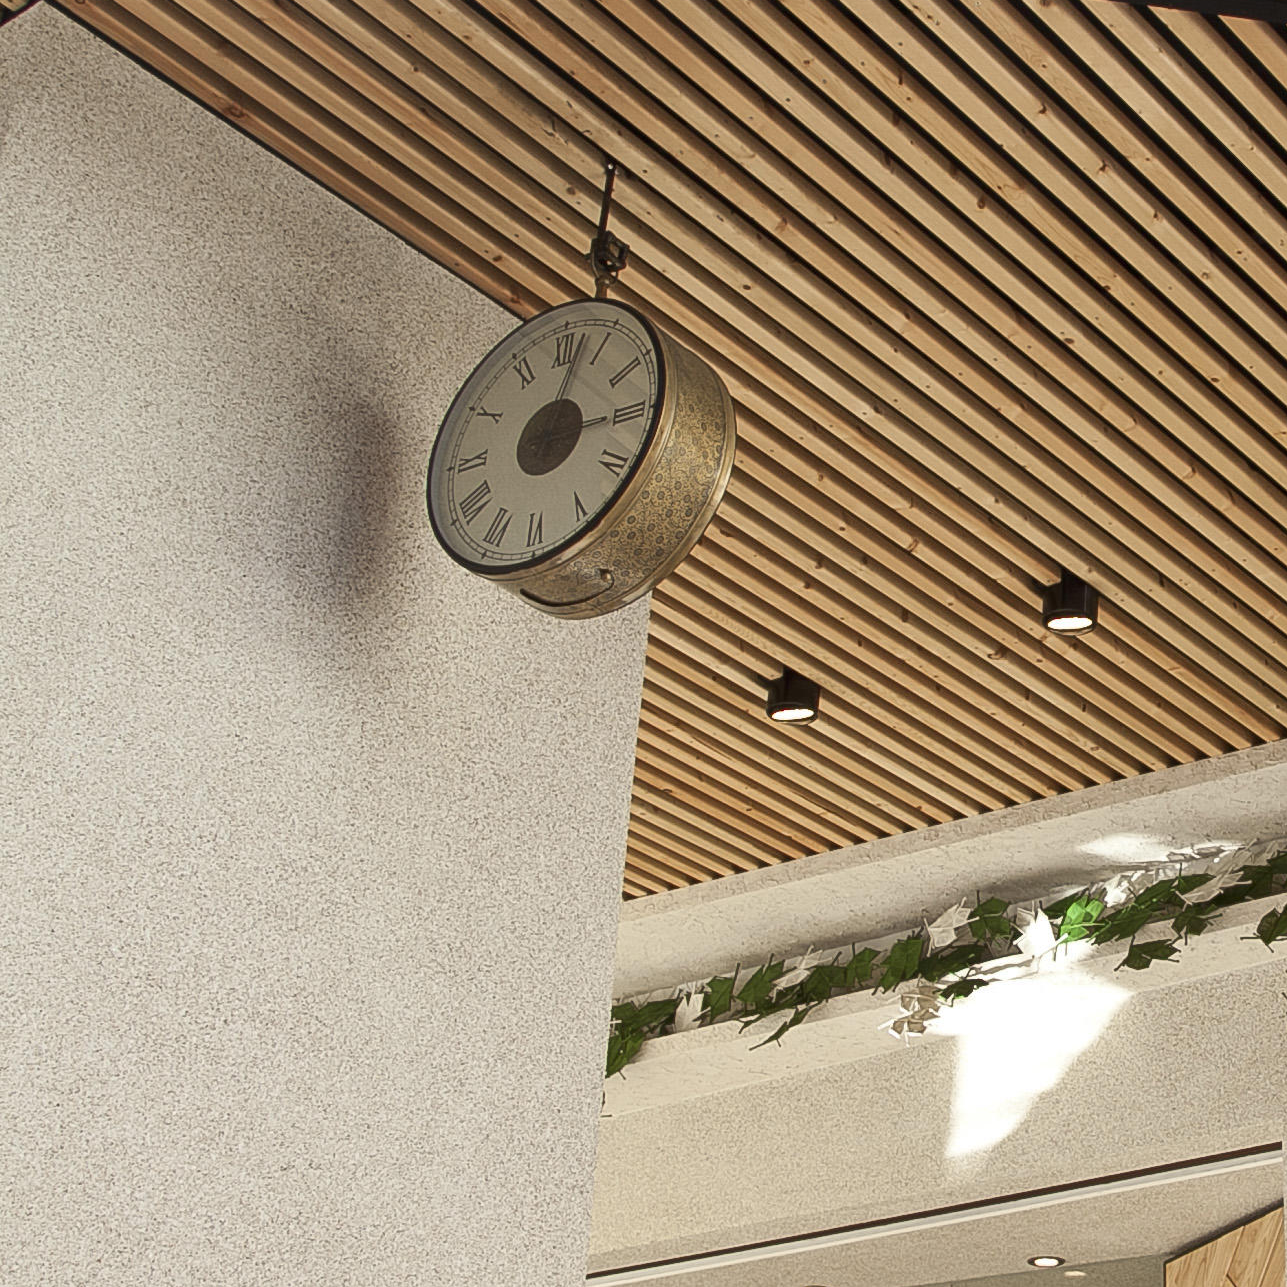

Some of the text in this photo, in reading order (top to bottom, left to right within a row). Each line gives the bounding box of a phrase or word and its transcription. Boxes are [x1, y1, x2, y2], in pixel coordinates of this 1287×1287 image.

[512, 356, 536, 390] XI
[609, 356, 641, 388] II
[476, 405, 503, 424] X
[612, 401, 646, 426] III
